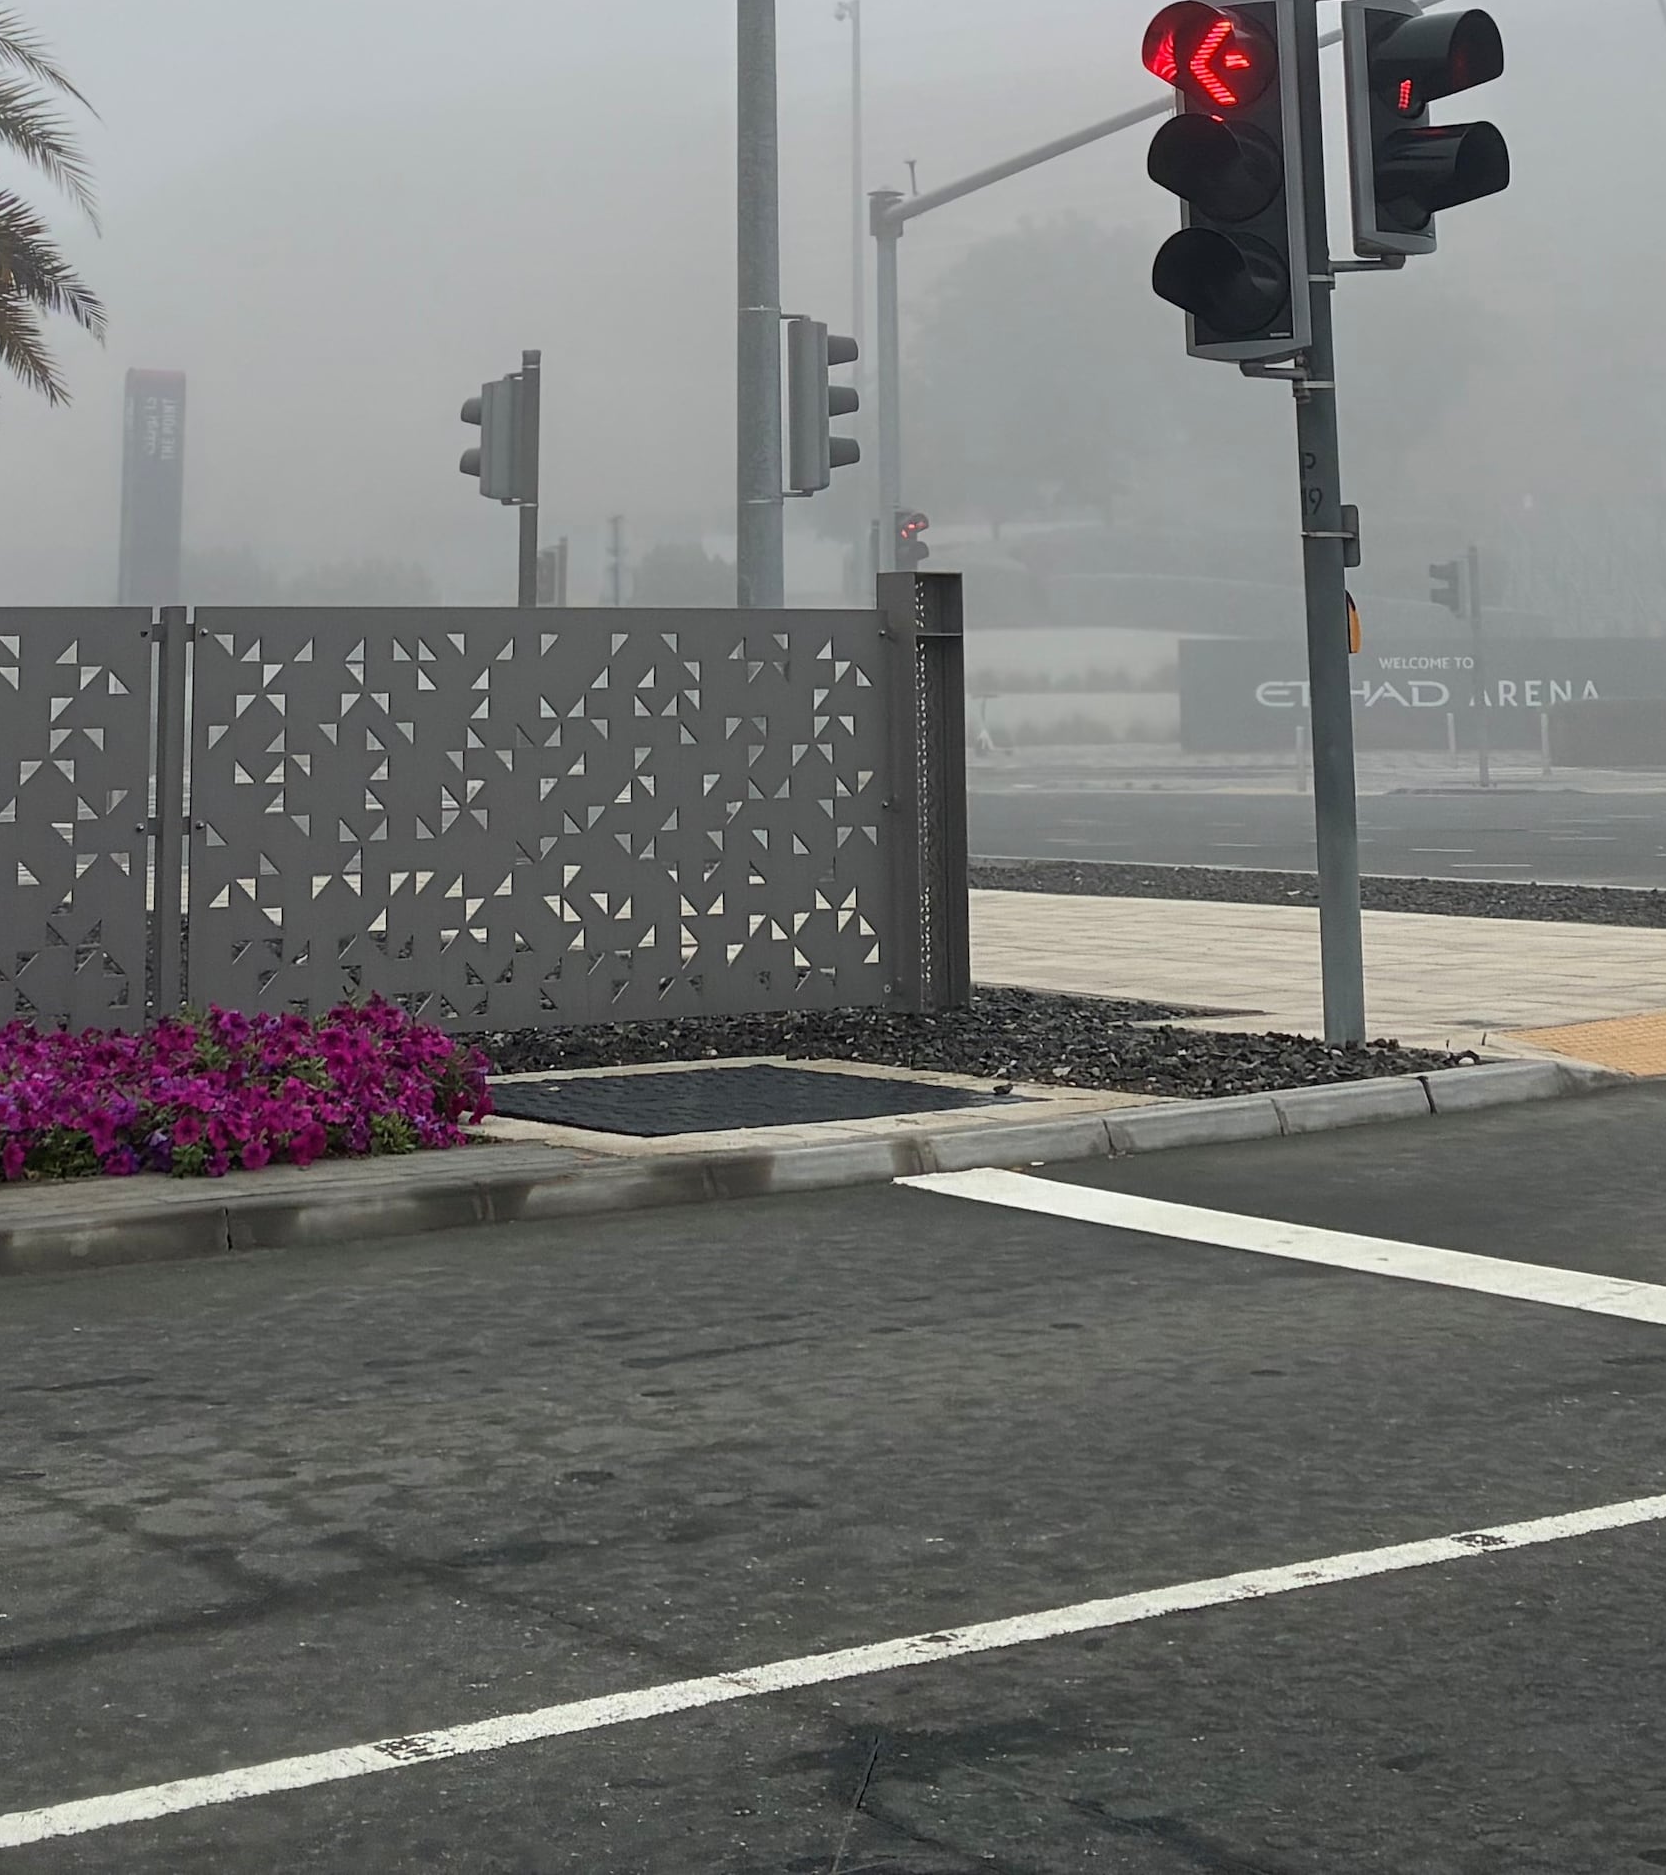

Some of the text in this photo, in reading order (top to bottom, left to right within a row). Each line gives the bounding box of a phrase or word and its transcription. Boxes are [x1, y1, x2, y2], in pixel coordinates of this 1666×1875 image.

[161, 397, 175, 460] THE POINT
[1379, 657, 1474, 669] WELCOME TO
[1255, 680, 1449, 707] ETHAD
